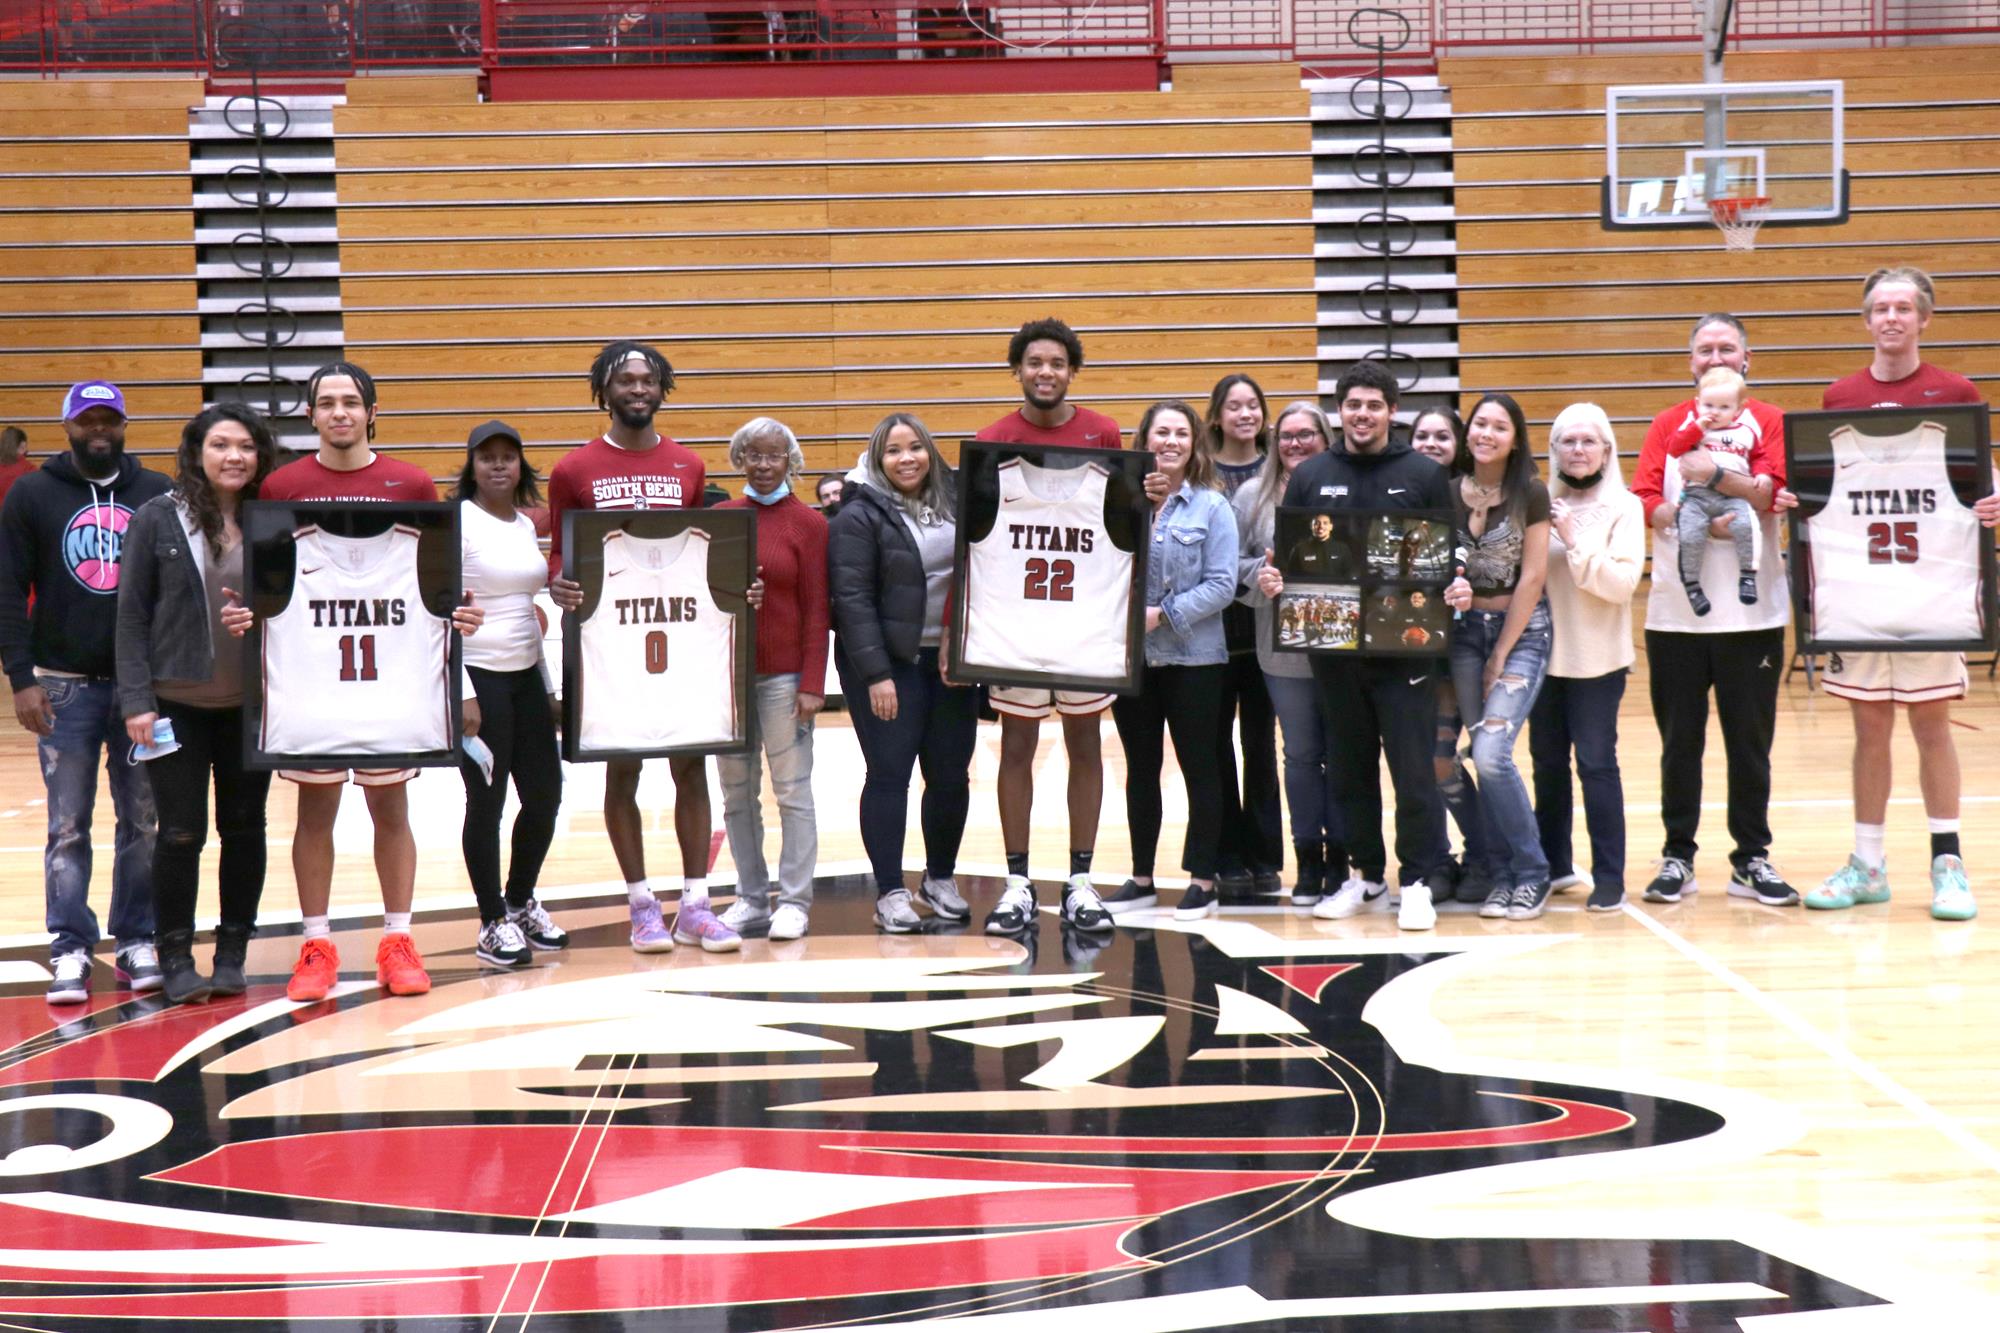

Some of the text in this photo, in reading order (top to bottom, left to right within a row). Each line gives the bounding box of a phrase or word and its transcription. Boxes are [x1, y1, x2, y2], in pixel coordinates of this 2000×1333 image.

[592, 475, 681, 487] INDIANA UNIVERSITY
[593, 482, 683, 501] SOUTH BEND
[1848, 488, 1936, 516] TITANS
[1009, 523, 1094, 554] TITANS
[1867, 521, 1919, 565] 25
[1024, 557, 1075, 602] 22
[309, 598, 406, 628] TITANS
[615, 596, 697, 625] TITANS
[339, 634, 378, 681] 11
[645, 630, 668, 675] 0
